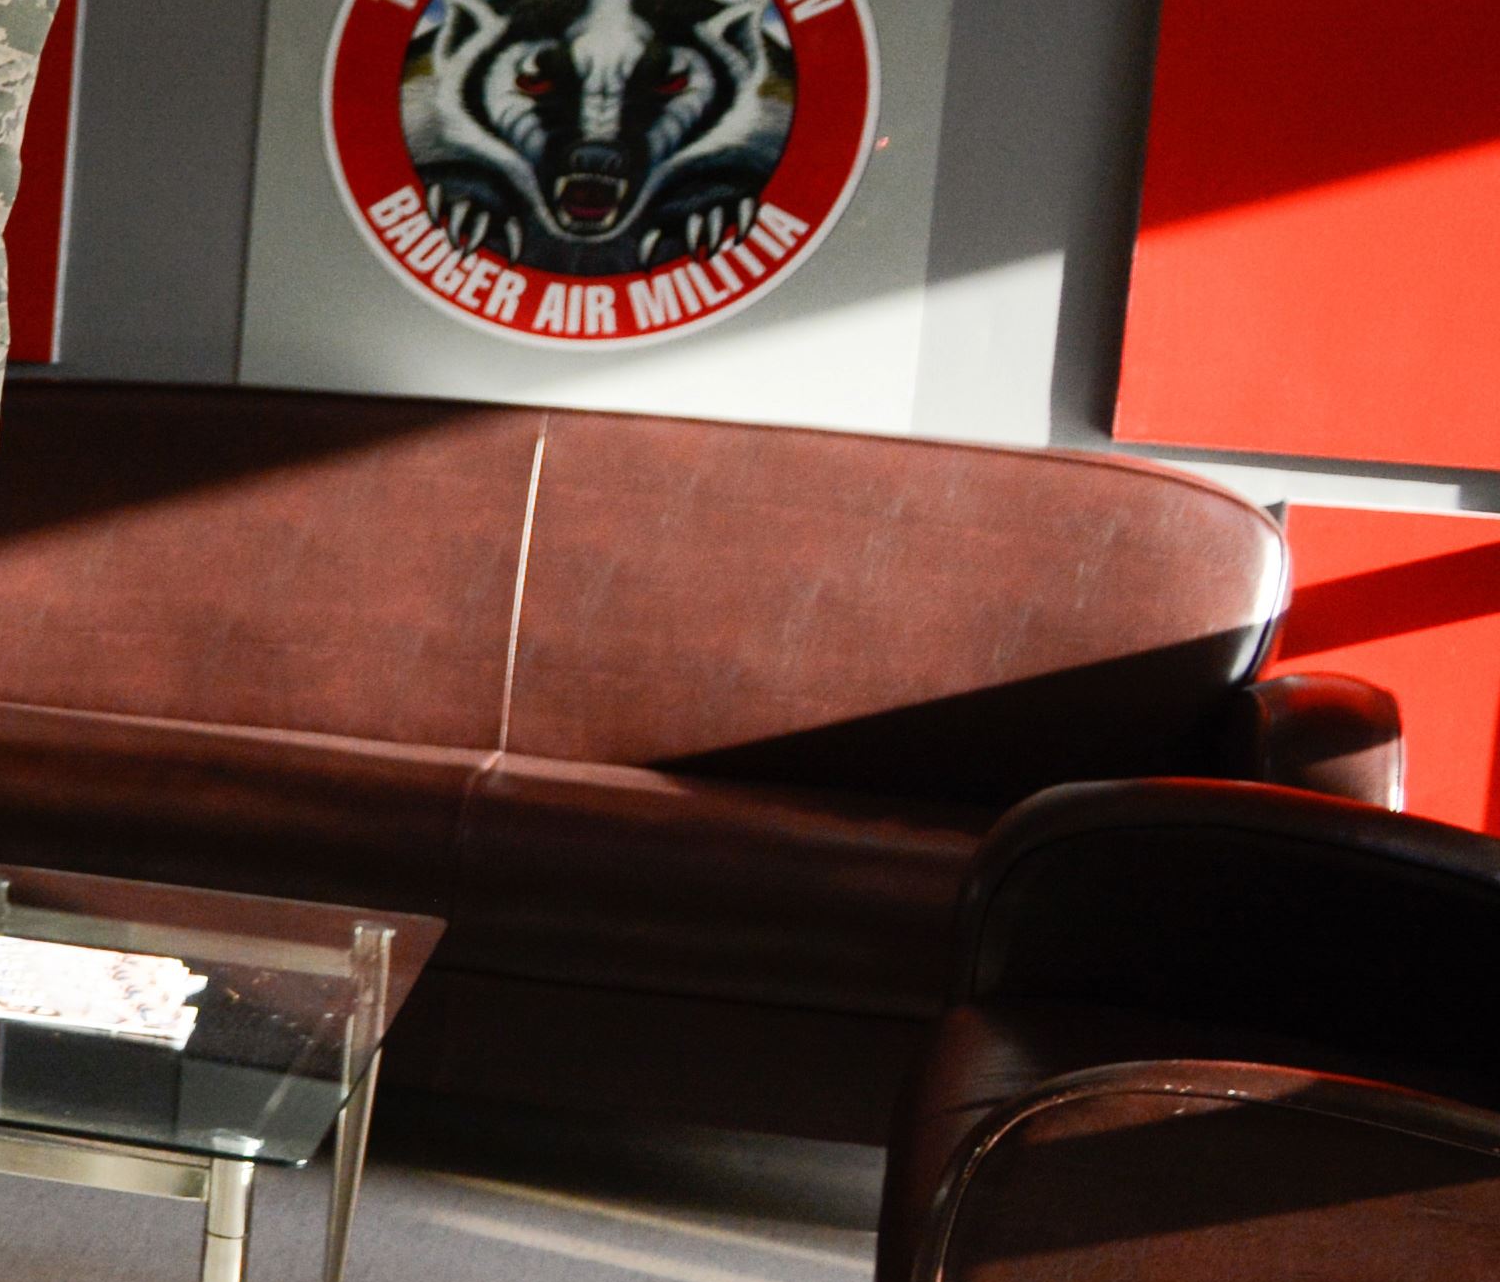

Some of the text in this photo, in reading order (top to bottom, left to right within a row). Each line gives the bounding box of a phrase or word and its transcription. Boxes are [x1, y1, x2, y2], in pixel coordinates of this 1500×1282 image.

[366, 184, 810, 335] BADGER AIR MILITIA
